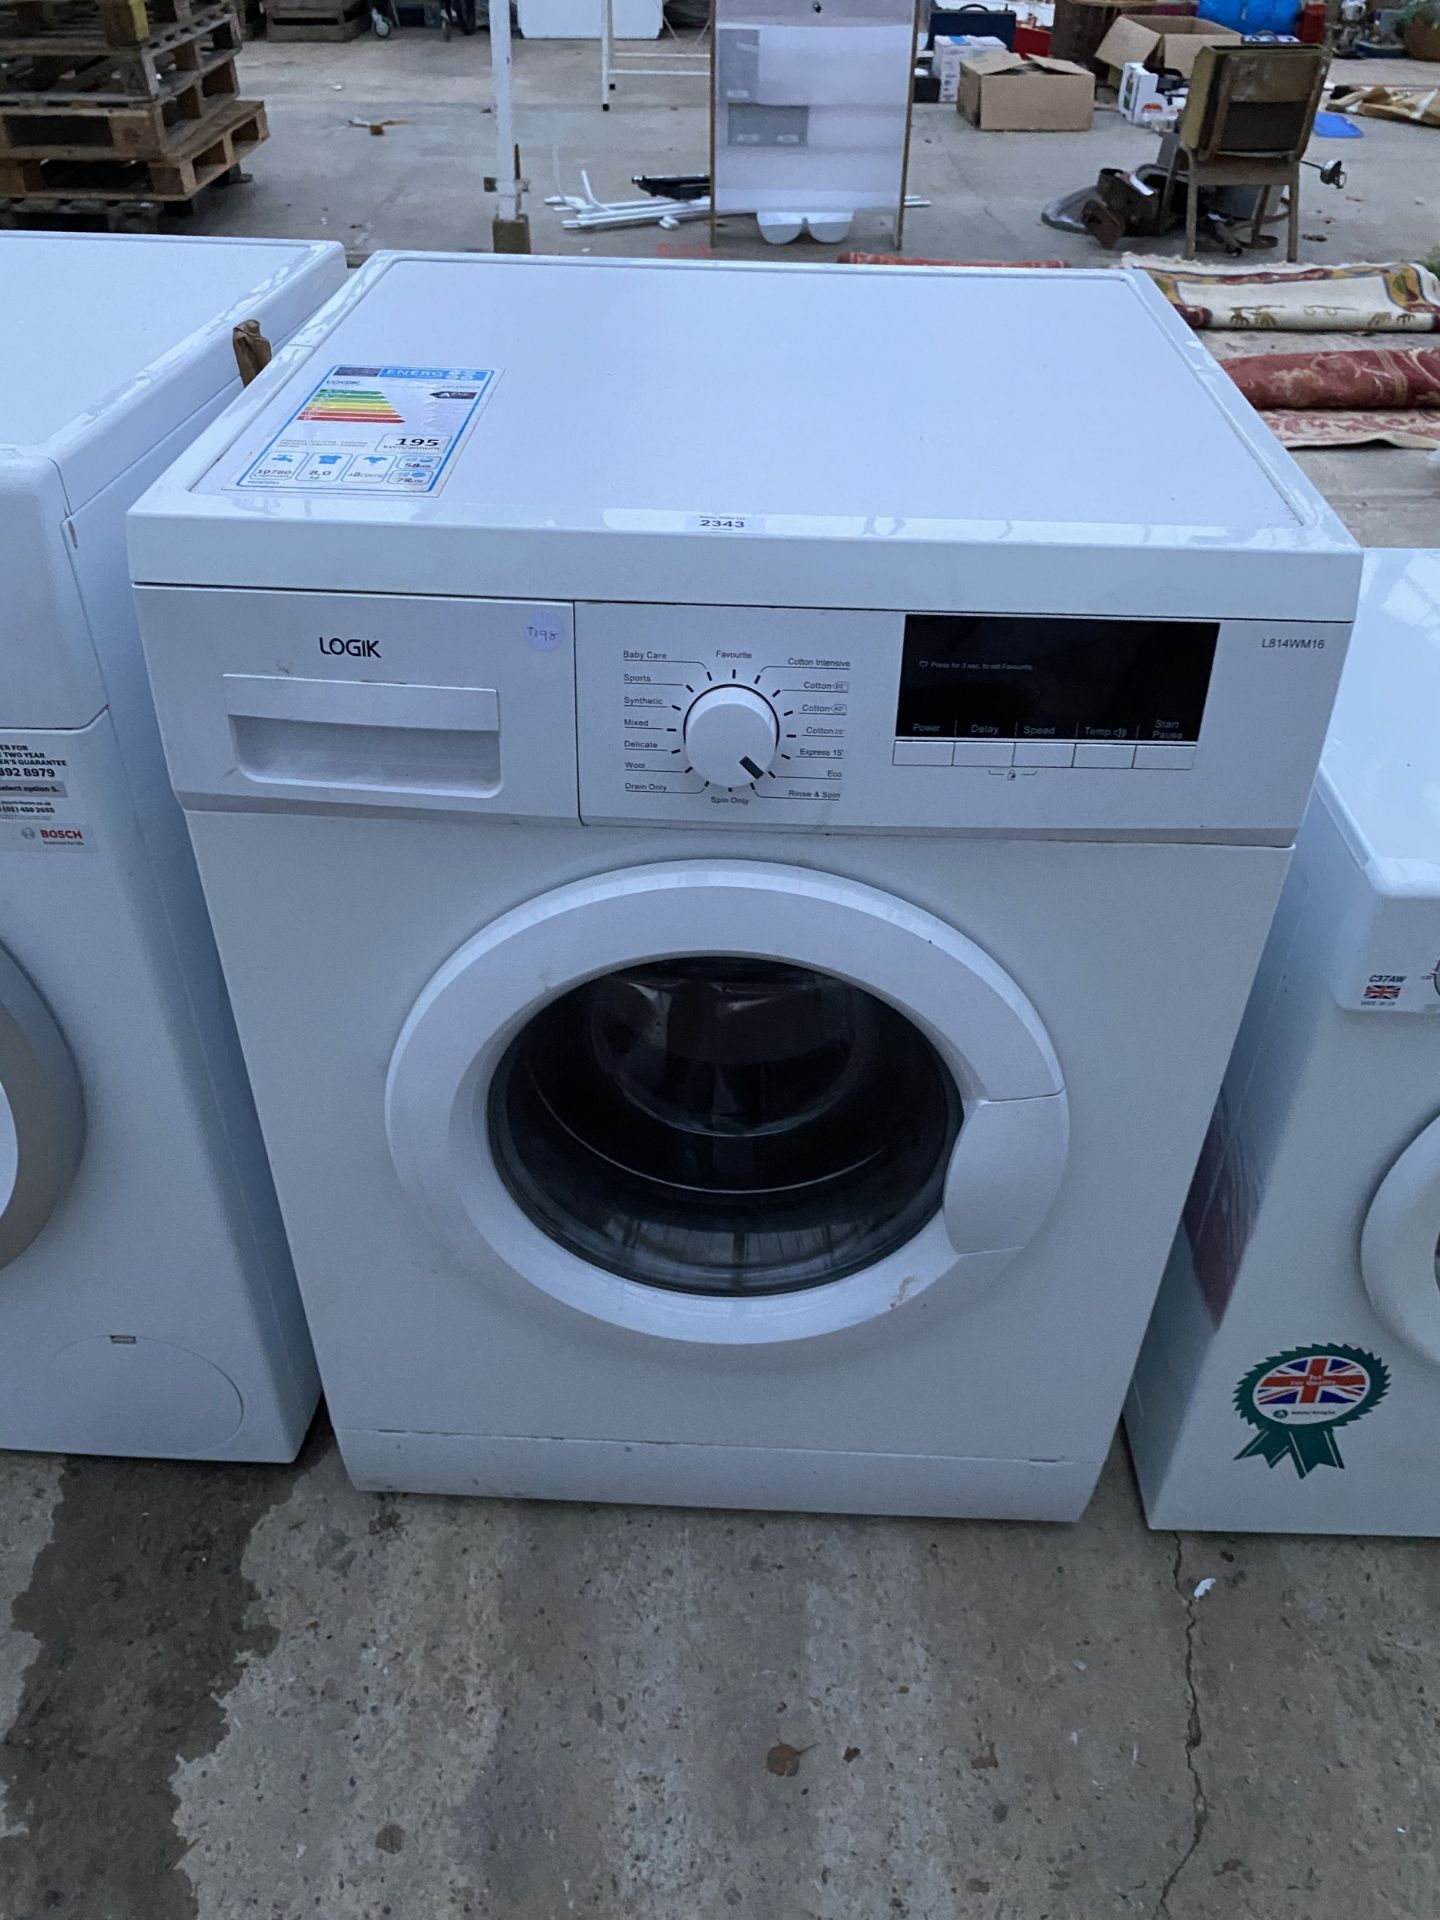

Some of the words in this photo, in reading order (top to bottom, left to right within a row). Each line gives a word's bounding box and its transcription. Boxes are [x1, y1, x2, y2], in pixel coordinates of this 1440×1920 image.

[394, 438, 441, 447] 195
[699, 519, 745, 529] 2343
[318, 636, 383, 659] LOGIK
[1261, 637, 1326, 650] L814WM16
[623, 650, 645, 660] Baby
[646, 650, 667, 660] Care
[715, 650, 753, 660] Favourite
[787, 657, 814, 666] Cotton
[815, 658, 851, 668] Intensive
[623, 673, 652, 683] Sports
[803, 681, 833, 690] Cotton
[623, 696, 664, 706] Synthetic
[801, 704, 830, 713] Cotton
[624, 718, 649, 727] Mixed
[1154, 719, 1180, 729] Start
[805, 726, 833, 735] Cotton
[912, 723, 942, 733] Power
[970, 723, 1000, 735] Delay
[1023, 724, 1056, 736] Speed
[1151, 730, 1184, 740] Pause
[624, 740, 659, 749] Delicate
[3, 751, 23, 759] TWO
[799, 748, 831, 757] Express
[624, 761, 646, 769] Wool
[23, 767, 55, 778] 8979
[826, 769, 843, 778] Eco
[624, 782, 648, 790] Drain
[649, 782, 667, 791] Only
[788, 789, 813, 798] Rinse
[814, 790, 820, 798] &
[821, 790, 841, 799] Spin
[710, 796, 730, 805] Spin
[730, 796, 750, 805] Only
[40, 829, 83, 839] BOSCH
